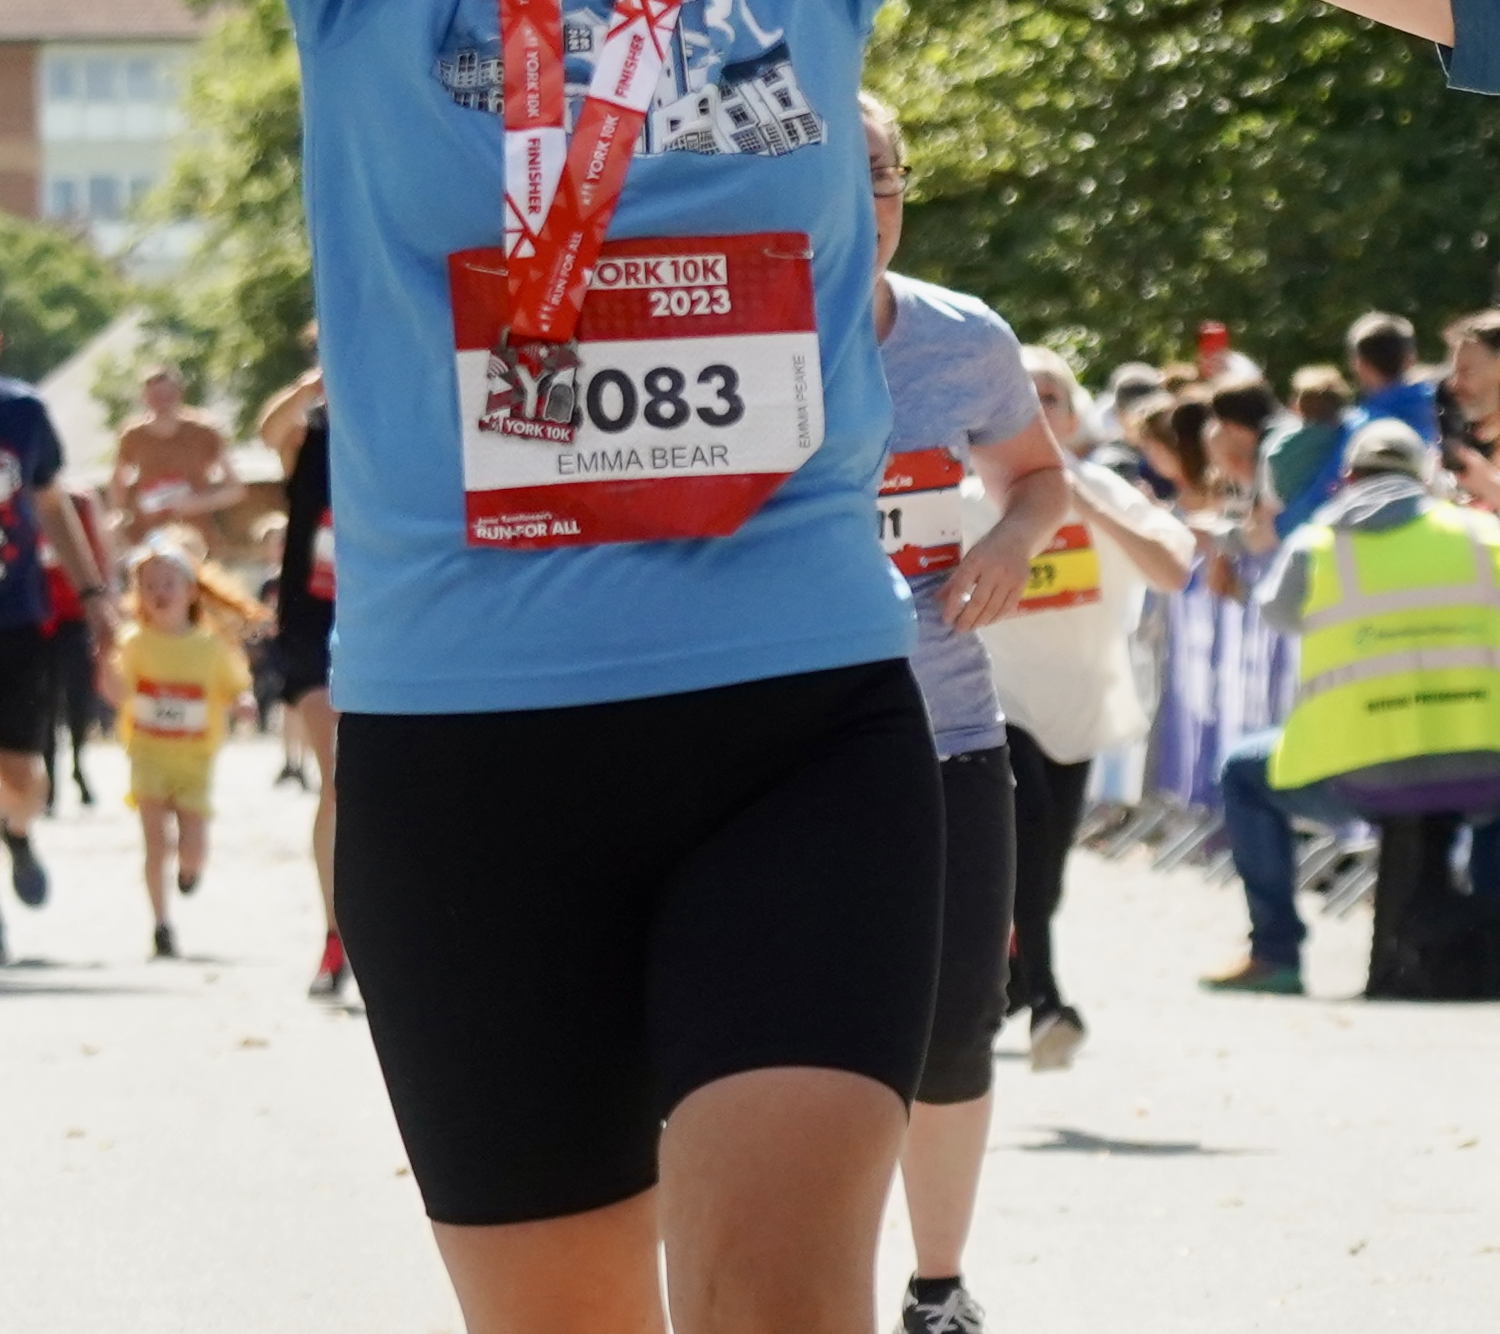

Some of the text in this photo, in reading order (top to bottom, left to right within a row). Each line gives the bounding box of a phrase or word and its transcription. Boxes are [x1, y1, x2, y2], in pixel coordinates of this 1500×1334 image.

[526, 51, 540, 90] YORK
[614, 33, 645, 99] FINISHER
[586, 114, 620, 181] YORK 10K
[527, 137, 542, 215] FINISHER
[551, 279, 568, 306] RUN
[561, 254, 576, 278] FOR
[588, 258, 723, 286] ORK 10K
[649, 287, 732, 317] 2023
[575, 364, 746, 435] 083
[504, 419, 572, 442] YORK 10K
[557, 445, 730, 476] EMMA BEAR
[552, 518, 582, 536] ALL
